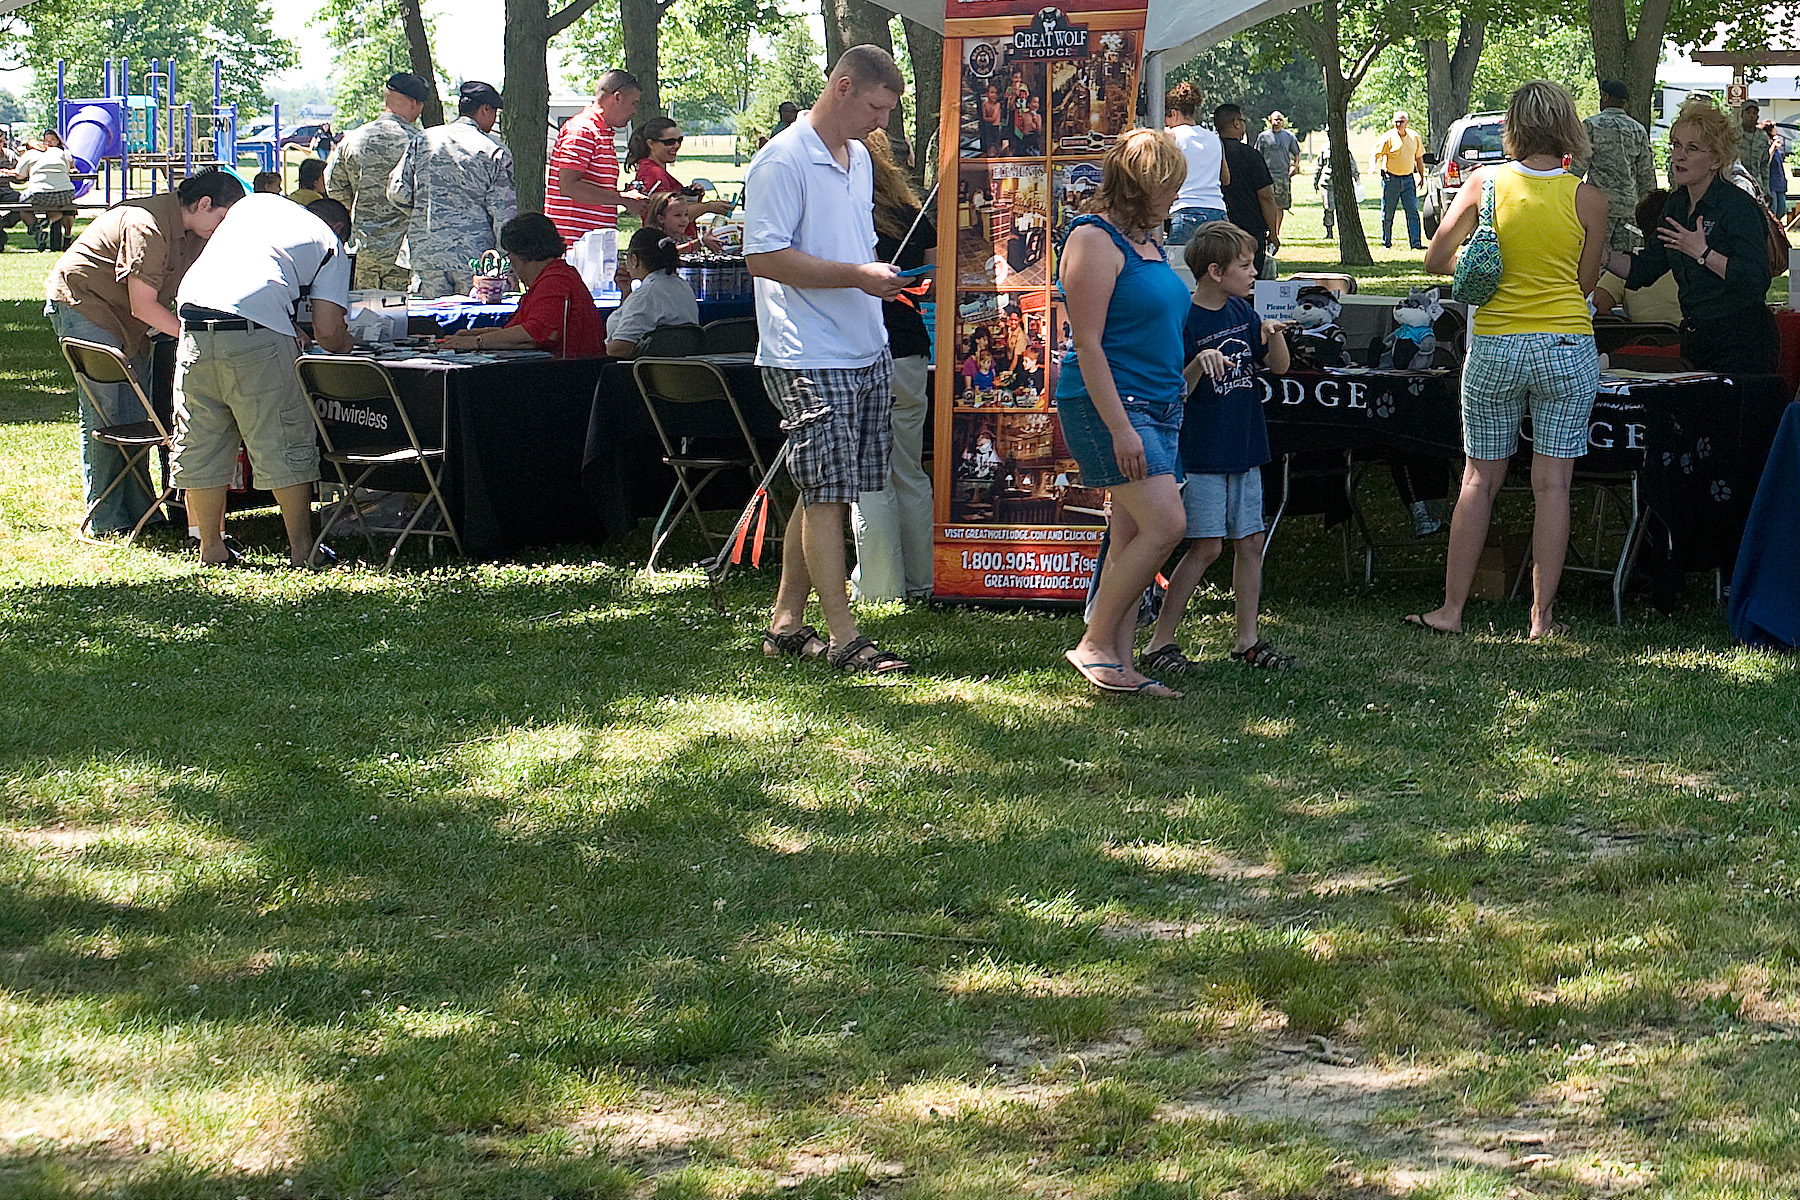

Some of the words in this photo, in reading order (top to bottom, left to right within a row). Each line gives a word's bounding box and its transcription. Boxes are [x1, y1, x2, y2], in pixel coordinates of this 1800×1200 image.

[1014, 31, 1053, 49] GREAT
[1054, 30, 1088, 47] WOLF
[1029, 47, 1072, 58] LODGE
[1266, 303, 1286, 311] Please
[944, 528, 965, 539] VISIT
[965, 528, 1046, 540] GREATWOLFLODGE.COM
[1047, 530, 1063, 540] AND
[1064, 529, 1086, 541] CLICK
[1086, 531, 1097, 541] ON
